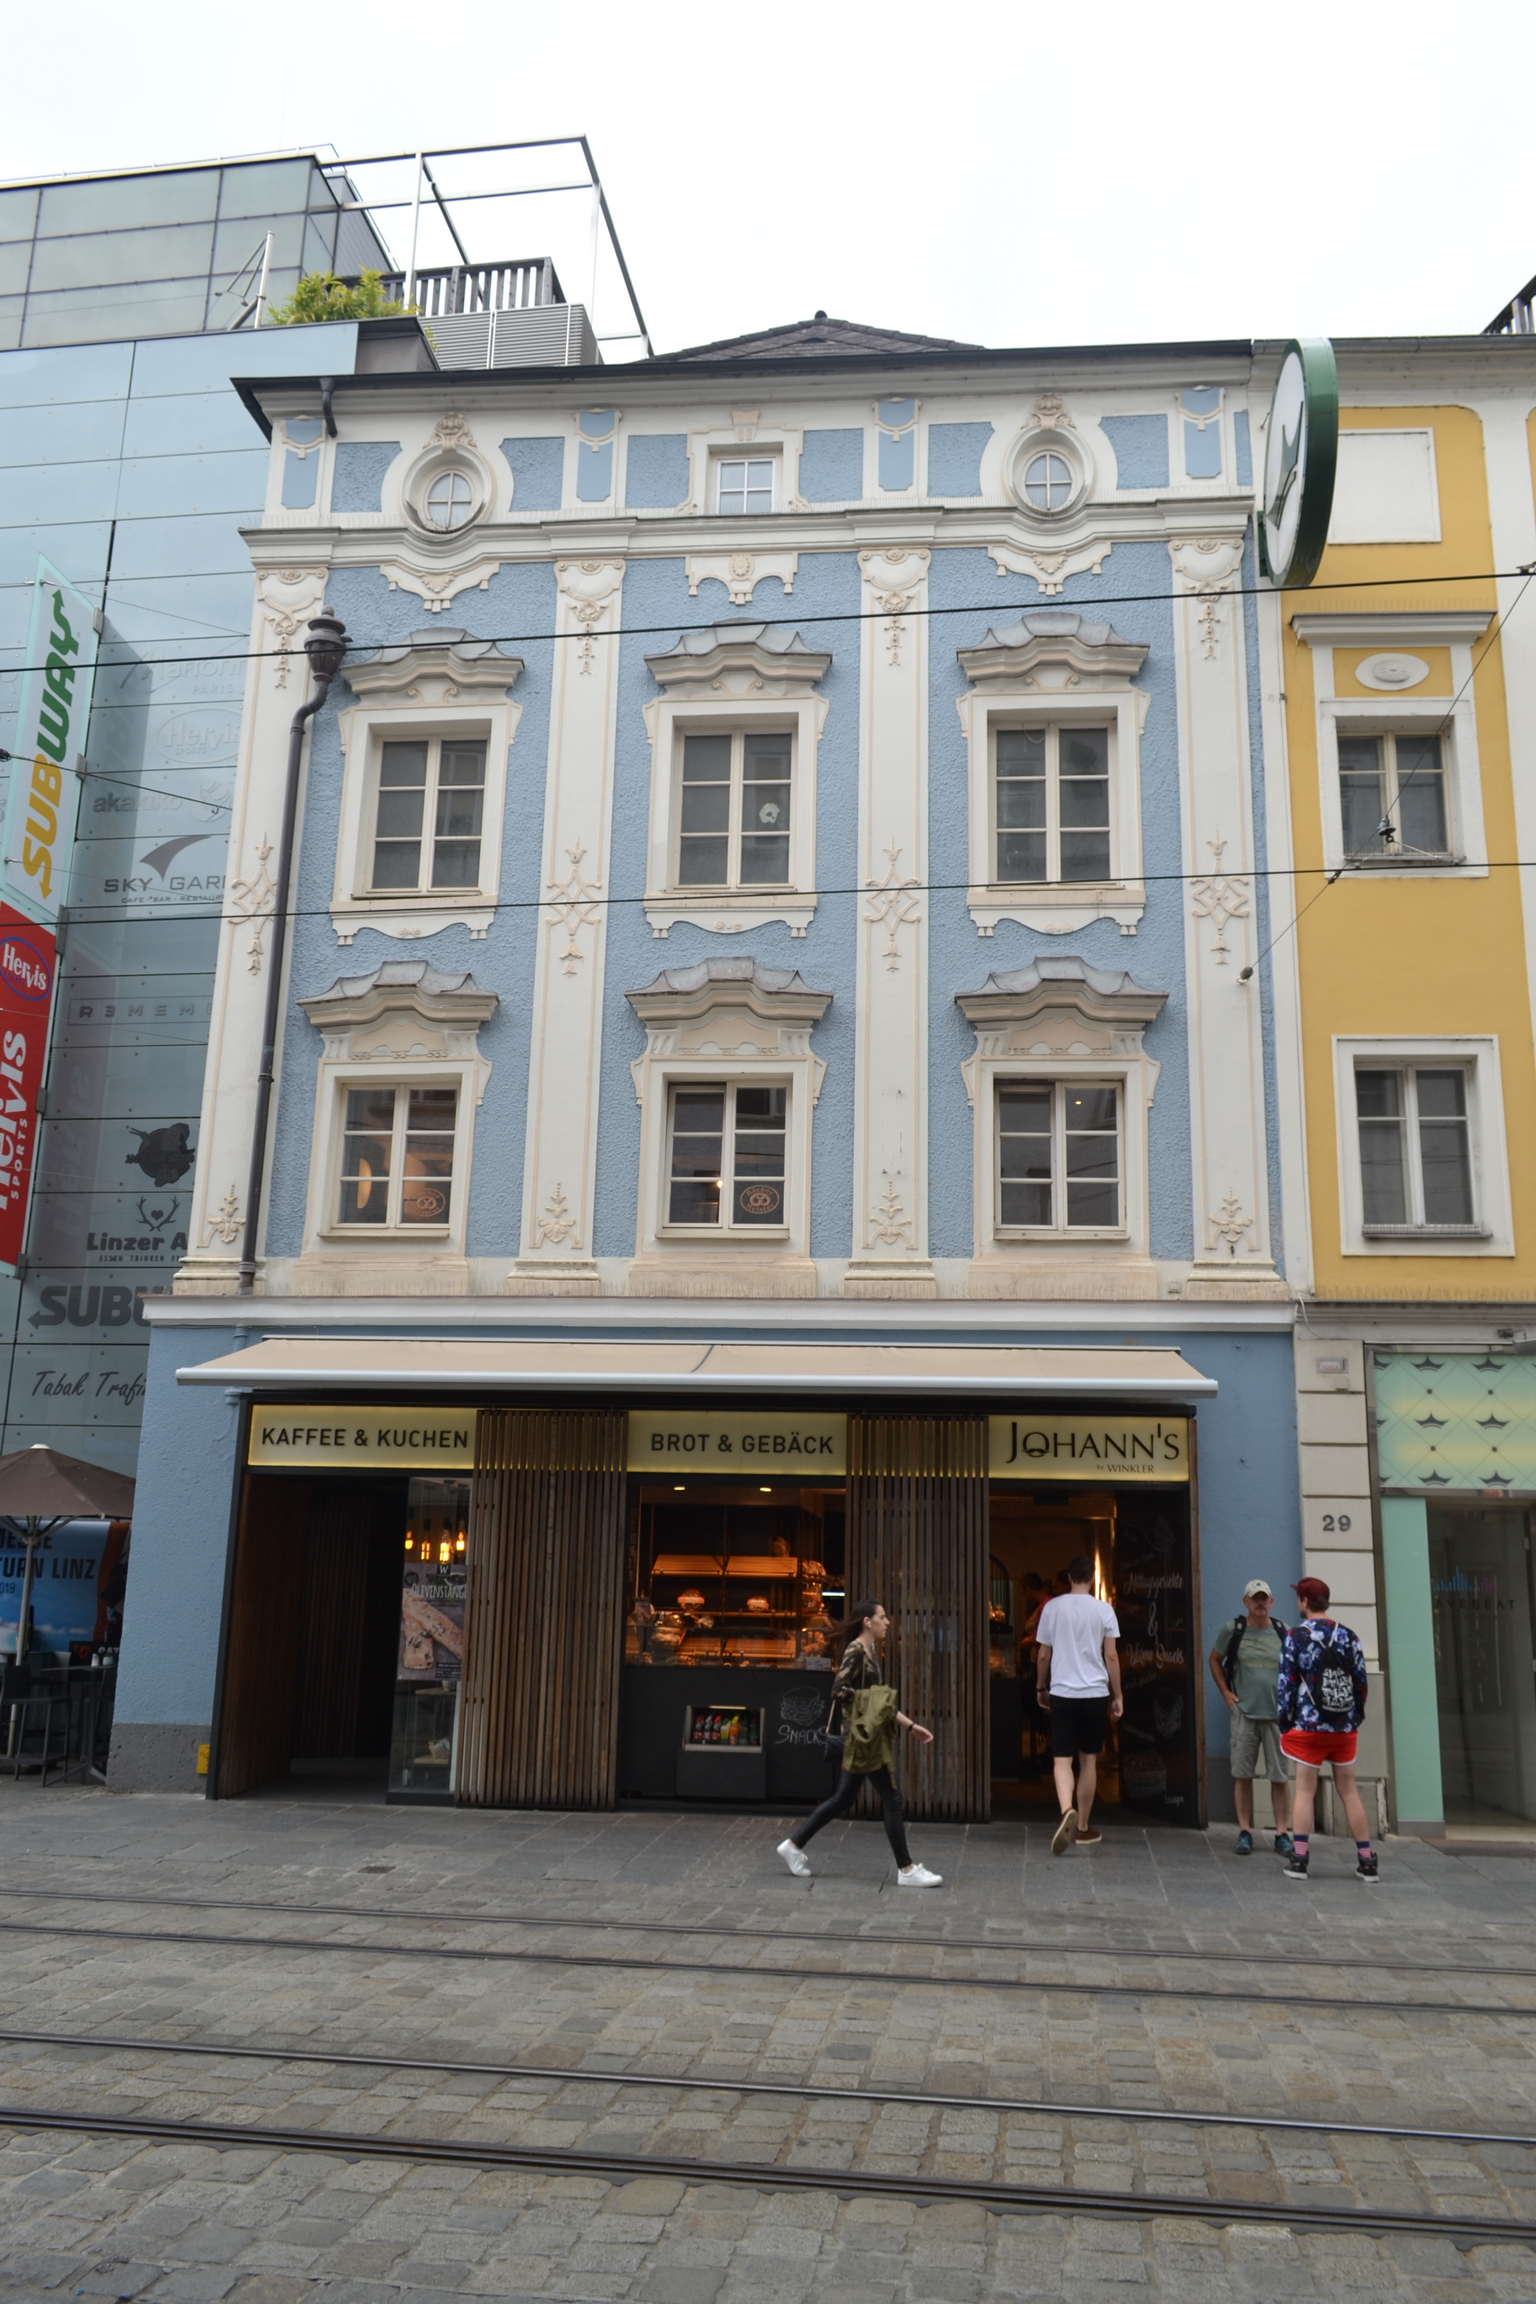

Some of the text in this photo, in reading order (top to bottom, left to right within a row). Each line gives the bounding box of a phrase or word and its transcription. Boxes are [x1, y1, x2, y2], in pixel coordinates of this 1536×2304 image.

[193, 684, 234, 695] PARIS
[23, 589, 80, 900] SUBWAY
[104, 875, 226, 893] SKY GAR
[2, 942, 48, 991] Hervis
[11, 1117, 28, 1199] SPORTS
[87, 1232, 165, 1251] Linzer
[99, 1255, 123, 1263] ESSEN
[32, 1370, 146, 1406] Tabak Trafi
[261, 1427, 468, 1449] KAFFEE & KUCHEN
[651, 1431, 834, 1455] BROT & GEBÄCK
[1006, 1421, 1180, 1464] JOHANN'S
[1106, 1463, 1155, 1475] WINKLER
[1322, 1514, 1352, 1532] 29
[51, 1558, 96, 1580] LINZ
[411, 1583, 467, 1600] OLIVENSTANG
[775, 1724, 828, 1746] SNACKS
